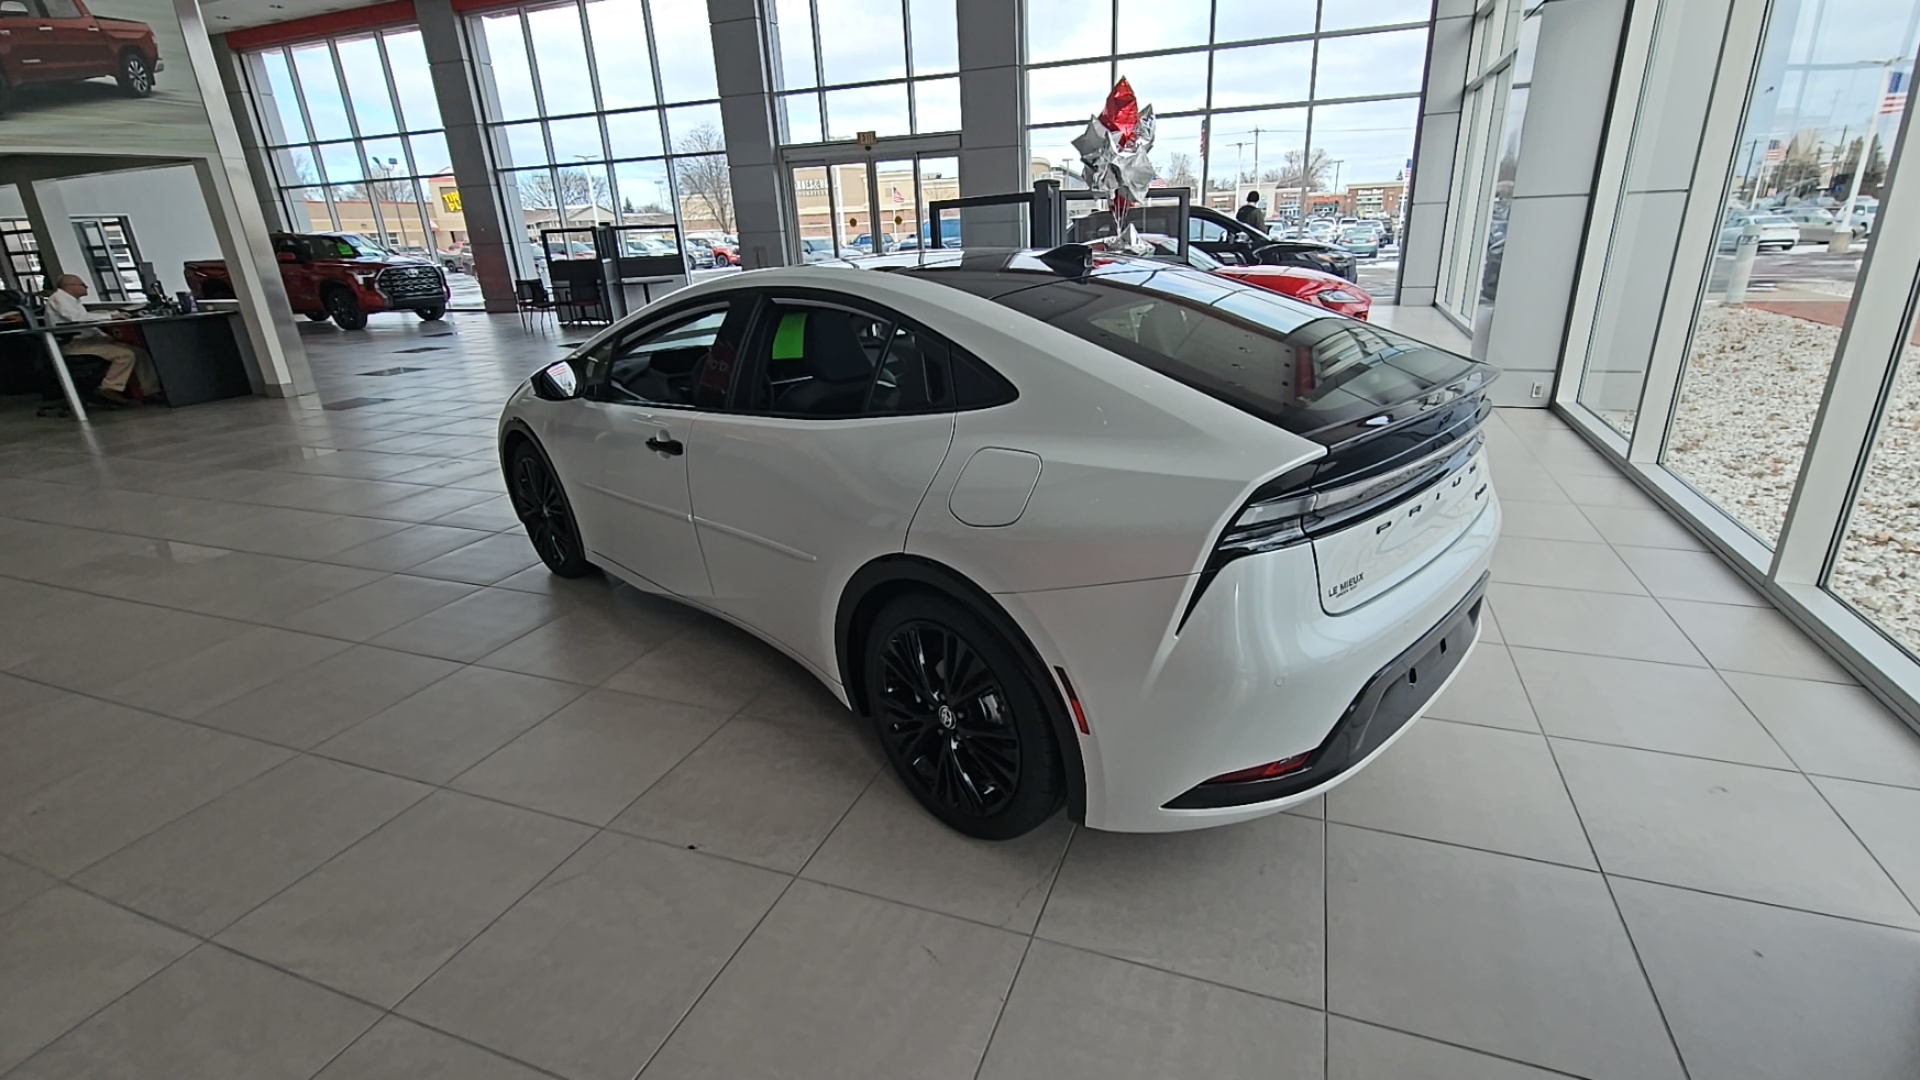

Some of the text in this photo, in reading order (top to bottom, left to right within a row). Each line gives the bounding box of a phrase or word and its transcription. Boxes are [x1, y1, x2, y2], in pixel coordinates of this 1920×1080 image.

[1376, 463, 1477, 535] PRIUS
[1328, 585, 1338, 598] LE
[1340, 572, 1364, 591] MIEUX
